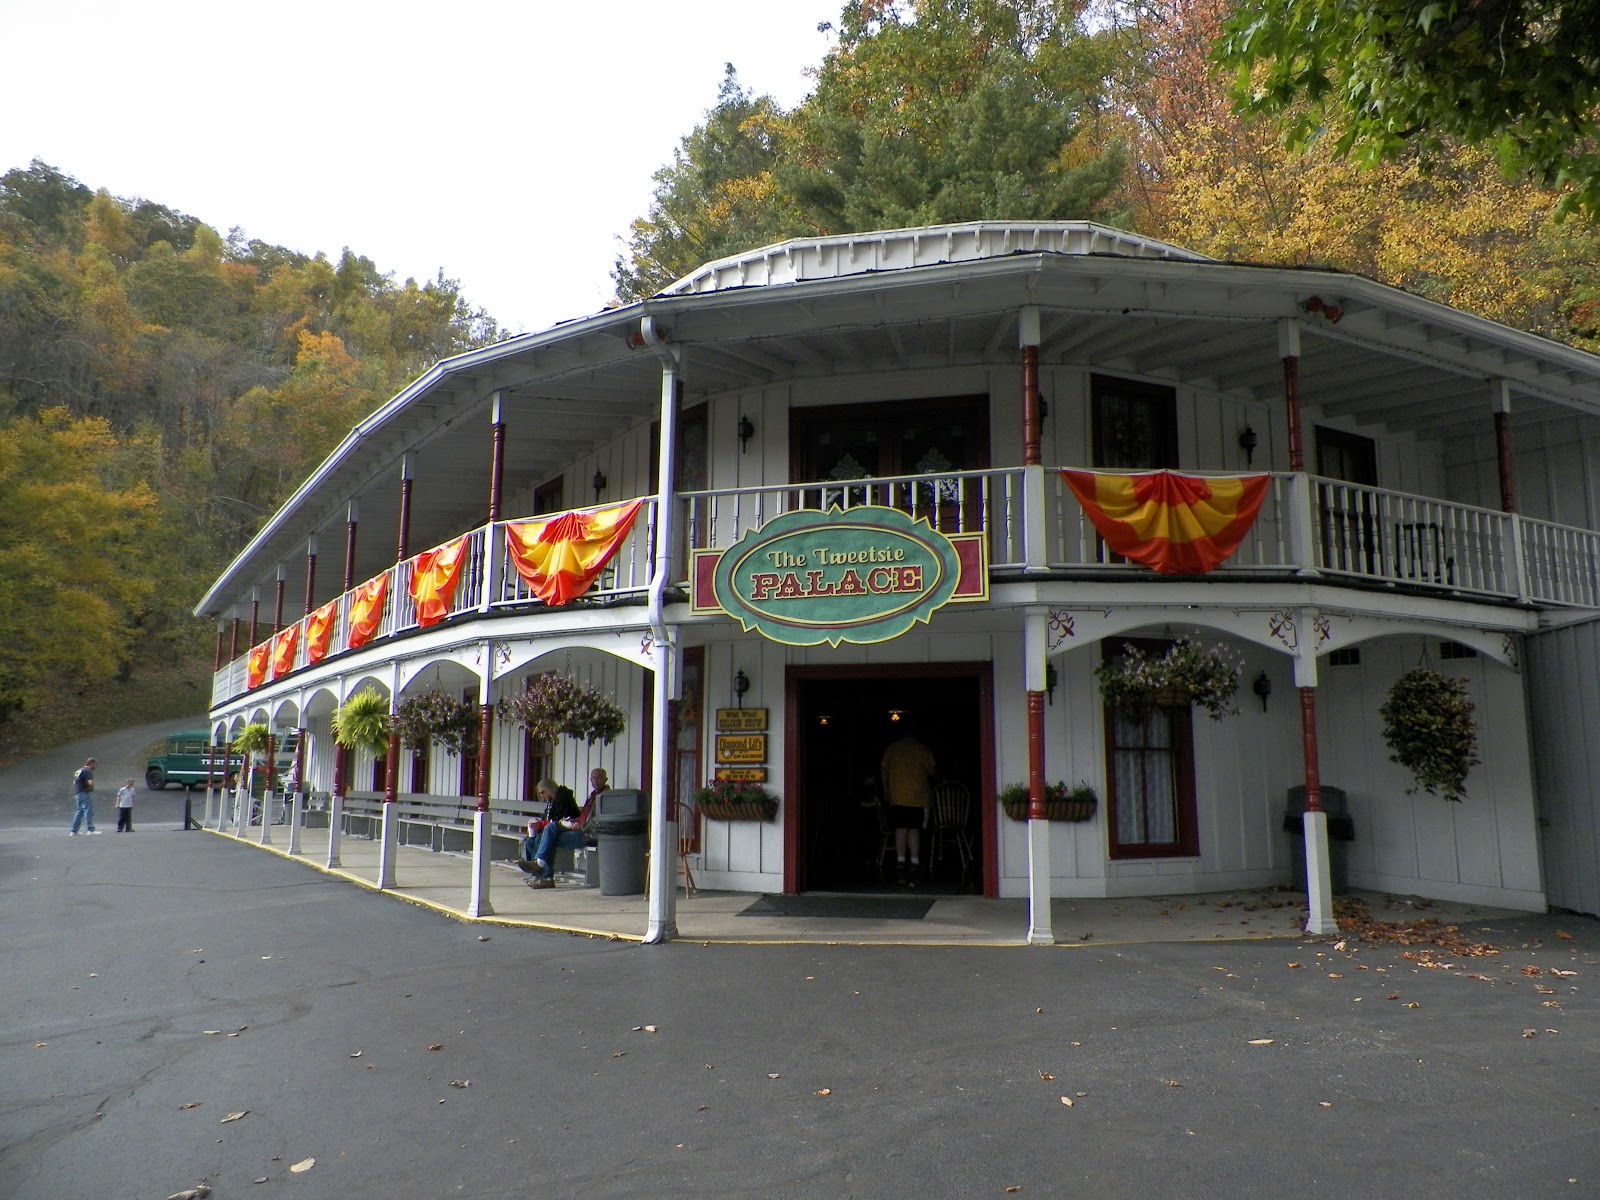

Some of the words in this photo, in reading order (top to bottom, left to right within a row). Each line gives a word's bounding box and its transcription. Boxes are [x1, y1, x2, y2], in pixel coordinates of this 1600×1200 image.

[766, 551, 807, 568] The
[812, 546, 905, 566] Tweetsie
[751, 565, 923, 600] PALACE
[719, 738, 747, 750] Diamond
